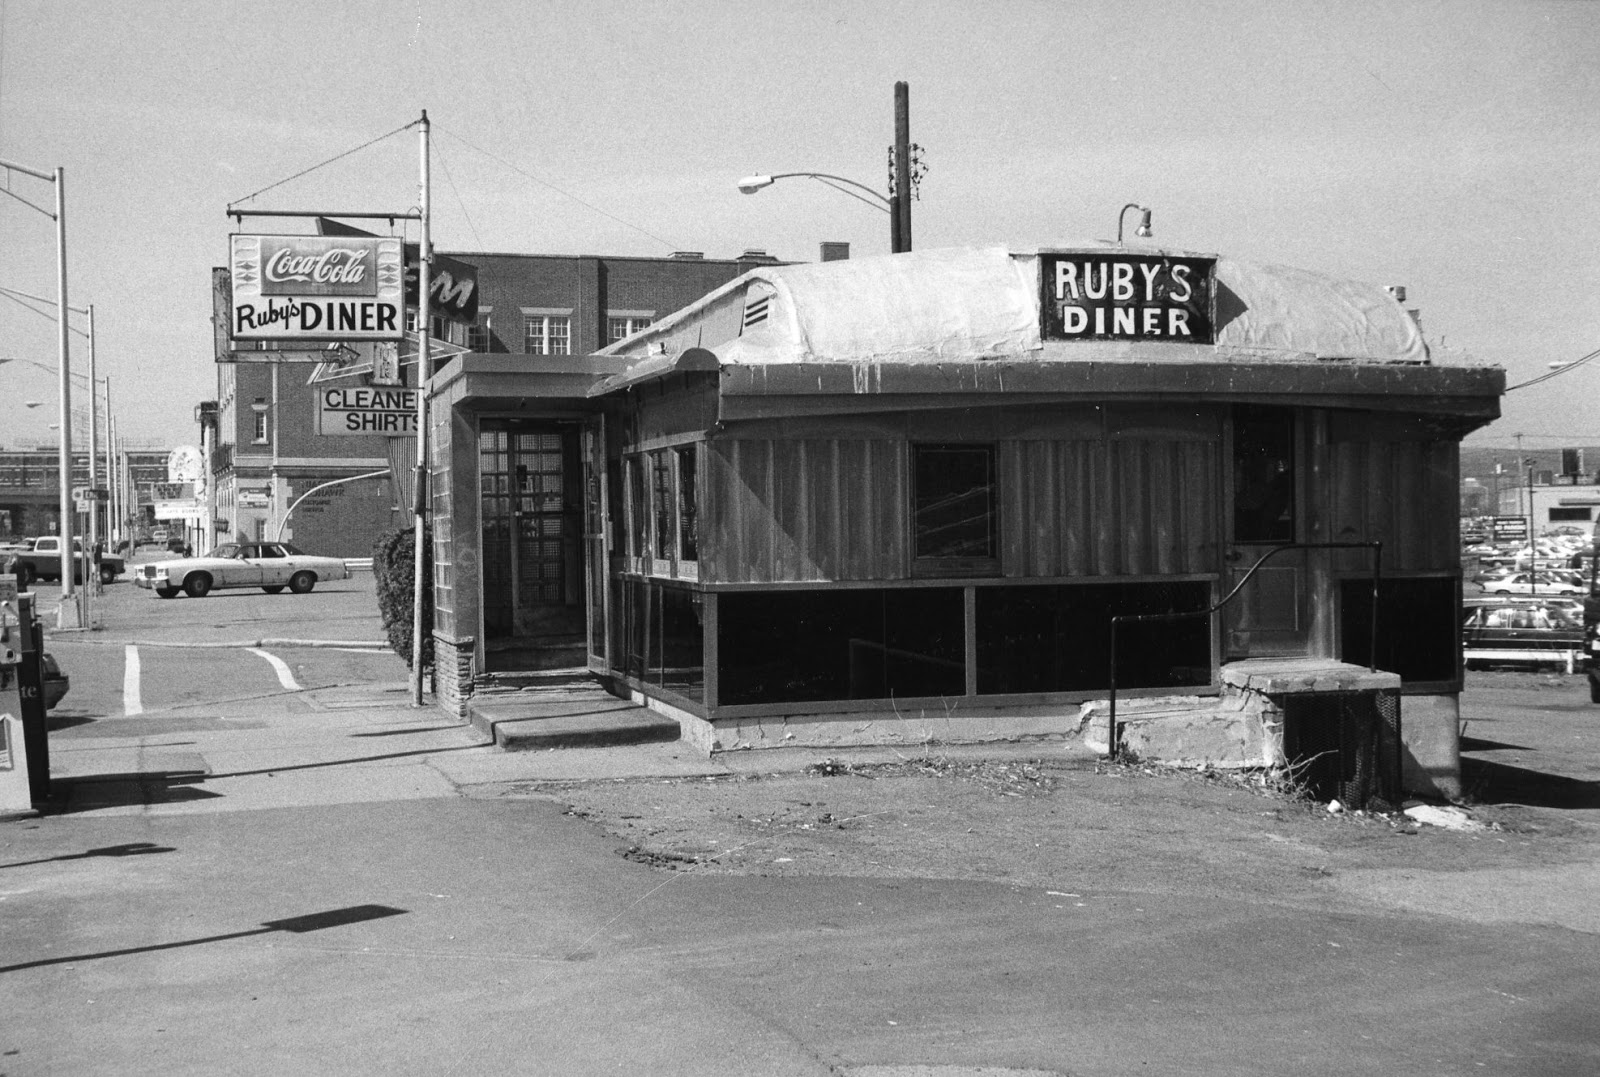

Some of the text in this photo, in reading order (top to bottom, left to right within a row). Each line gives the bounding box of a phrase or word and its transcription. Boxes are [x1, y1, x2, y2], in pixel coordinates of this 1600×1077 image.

[265, 247, 370, 283] Coca-Cola
[1055, 260, 1192, 302] RUBY'S
[236, 297, 397, 333] Ruby's DINER
[1063, 305, 1192, 336] DINER
[325, 389, 418, 409] CLEANE
